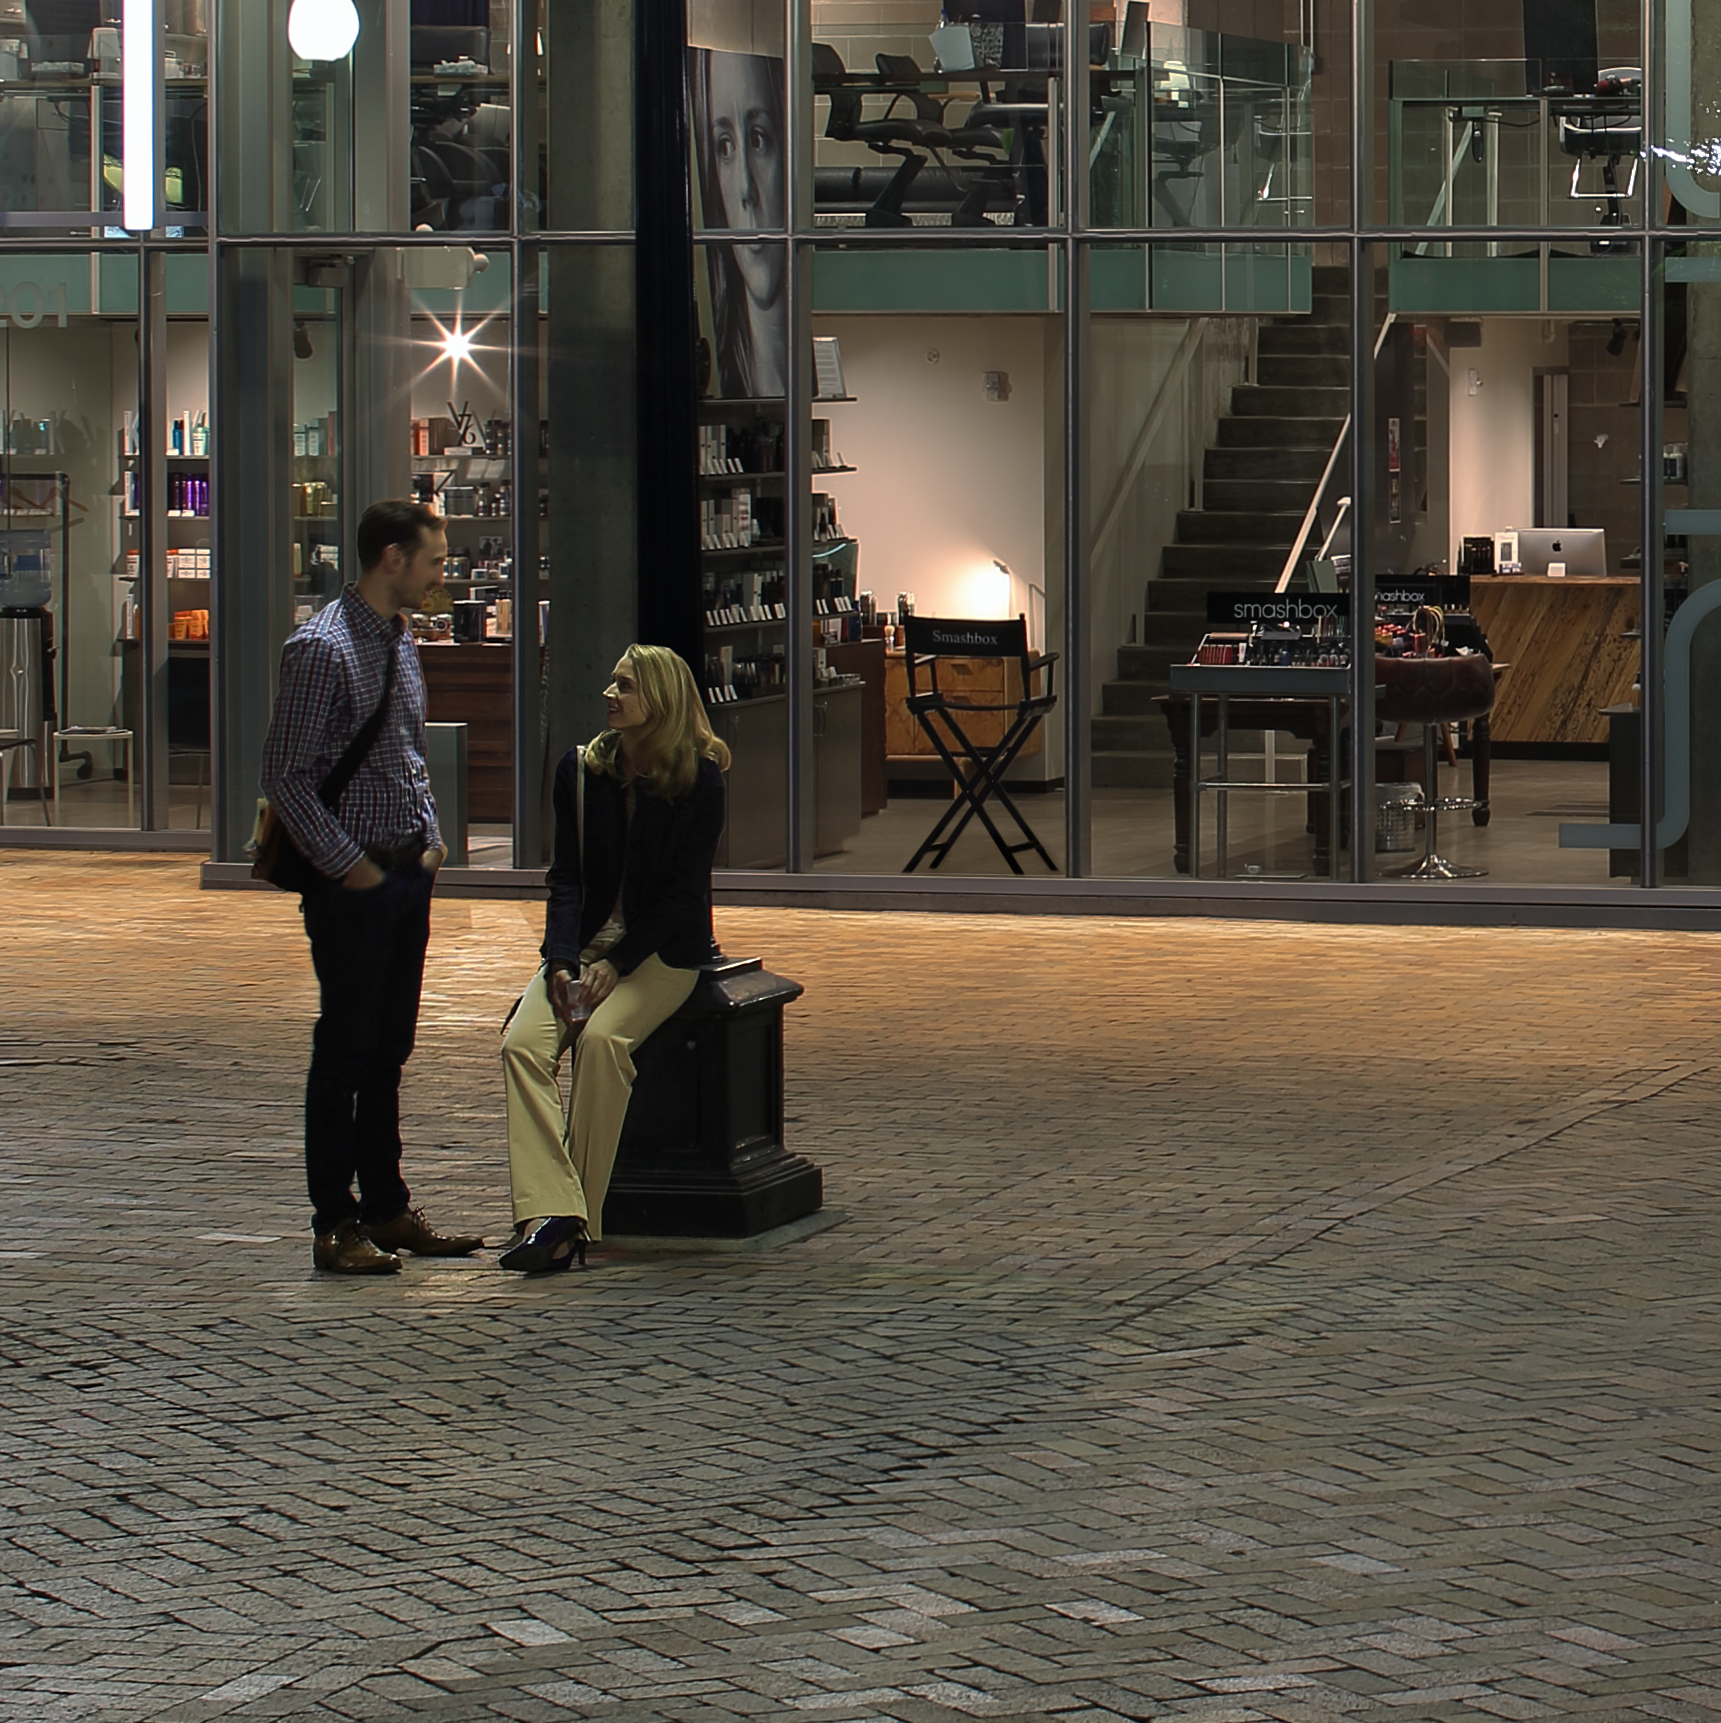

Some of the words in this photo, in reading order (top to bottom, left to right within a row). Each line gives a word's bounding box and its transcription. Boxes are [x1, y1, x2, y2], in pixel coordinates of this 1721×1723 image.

[0, 281, 68, 329] 01
[1234, 597, 1338, 619] smashbox
[932, 629, 998, 645] Smashbox
